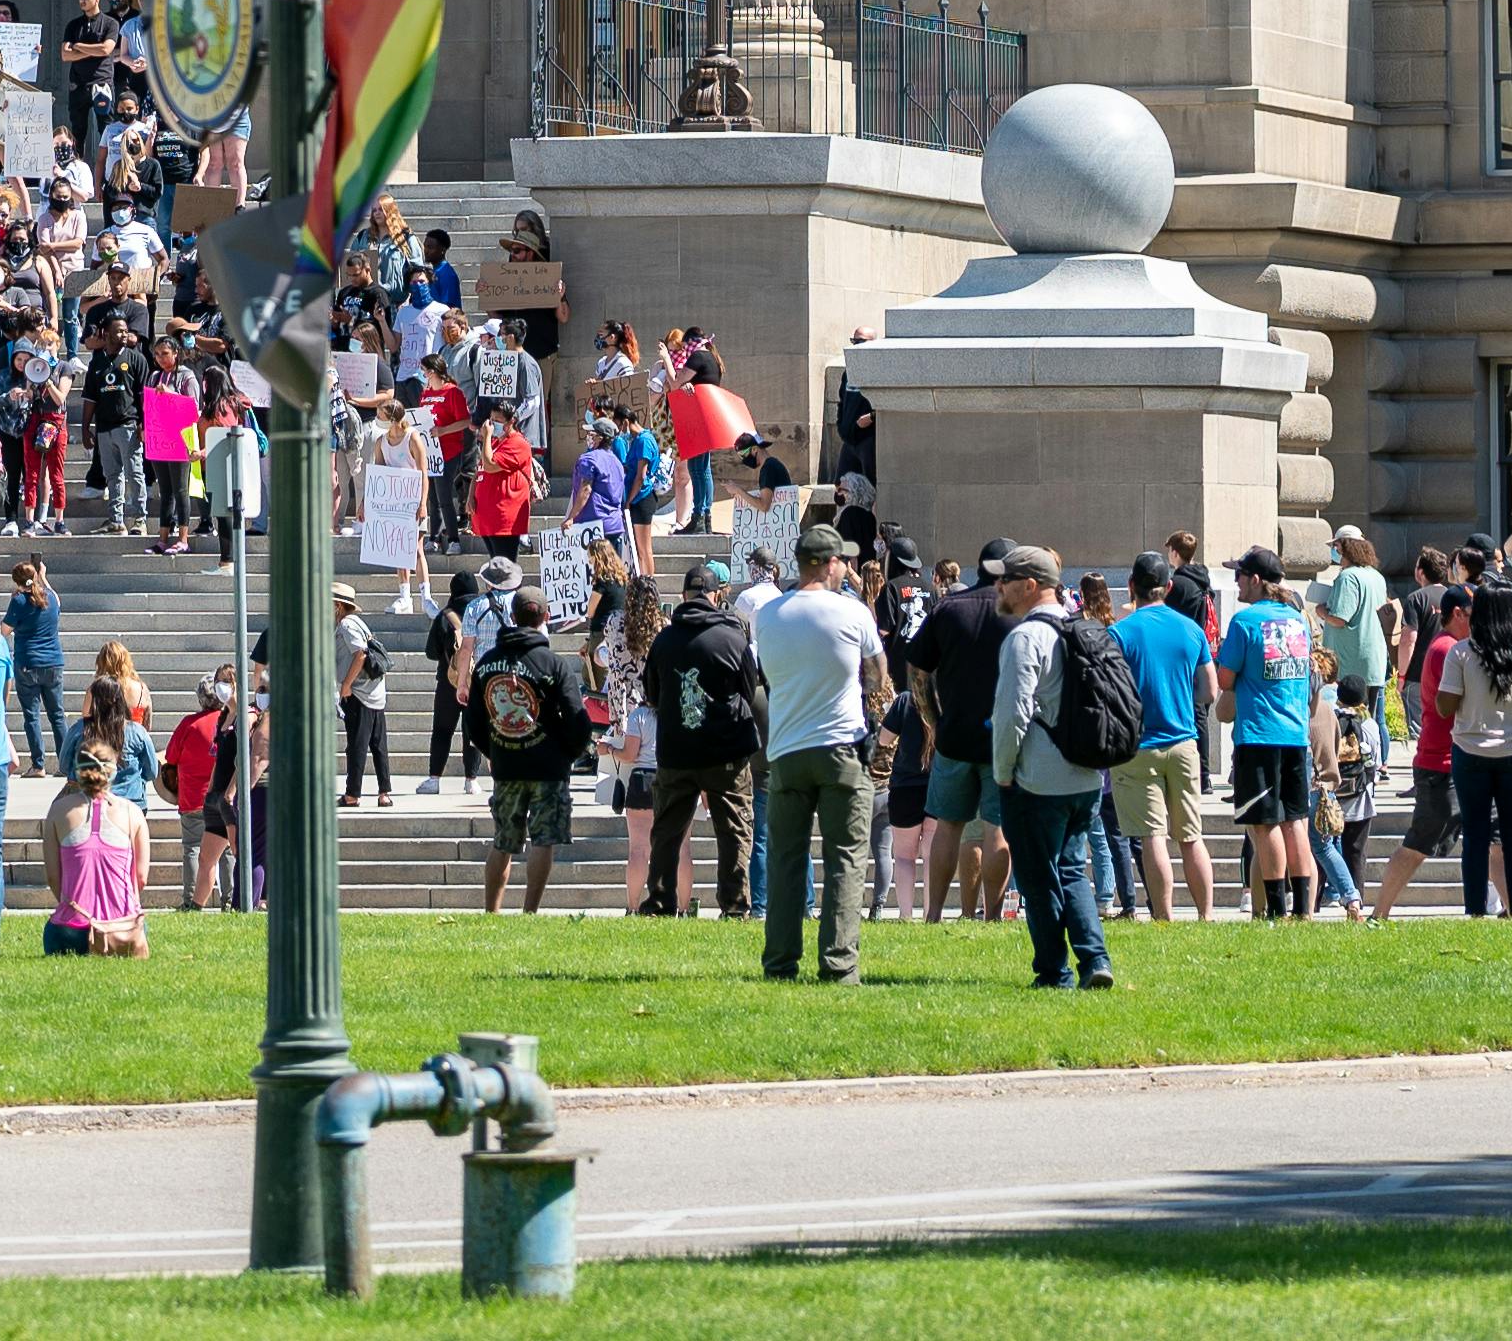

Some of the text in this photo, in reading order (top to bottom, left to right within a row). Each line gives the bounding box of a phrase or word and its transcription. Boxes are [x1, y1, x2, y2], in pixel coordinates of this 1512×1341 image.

[9, 156, 50, 172] PEOPLE
[485, 285, 509, 297] STOP
[483, 352, 516, 367] Justice
[483, 383, 514, 396] FLOYD
[590, 376, 631, 396] END
[366, 475, 386, 499] NO
[736, 501, 800, 526] JUSTICE
[364, 519, 415, 557] NO PEACE
[733, 523, 799, 540] UP FOR
[552, 550, 573, 562] FOR
[544, 564, 581, 583] BLACK
[547, 583, 580, 602] LIVES
[477, 660, 509, 679] Death
